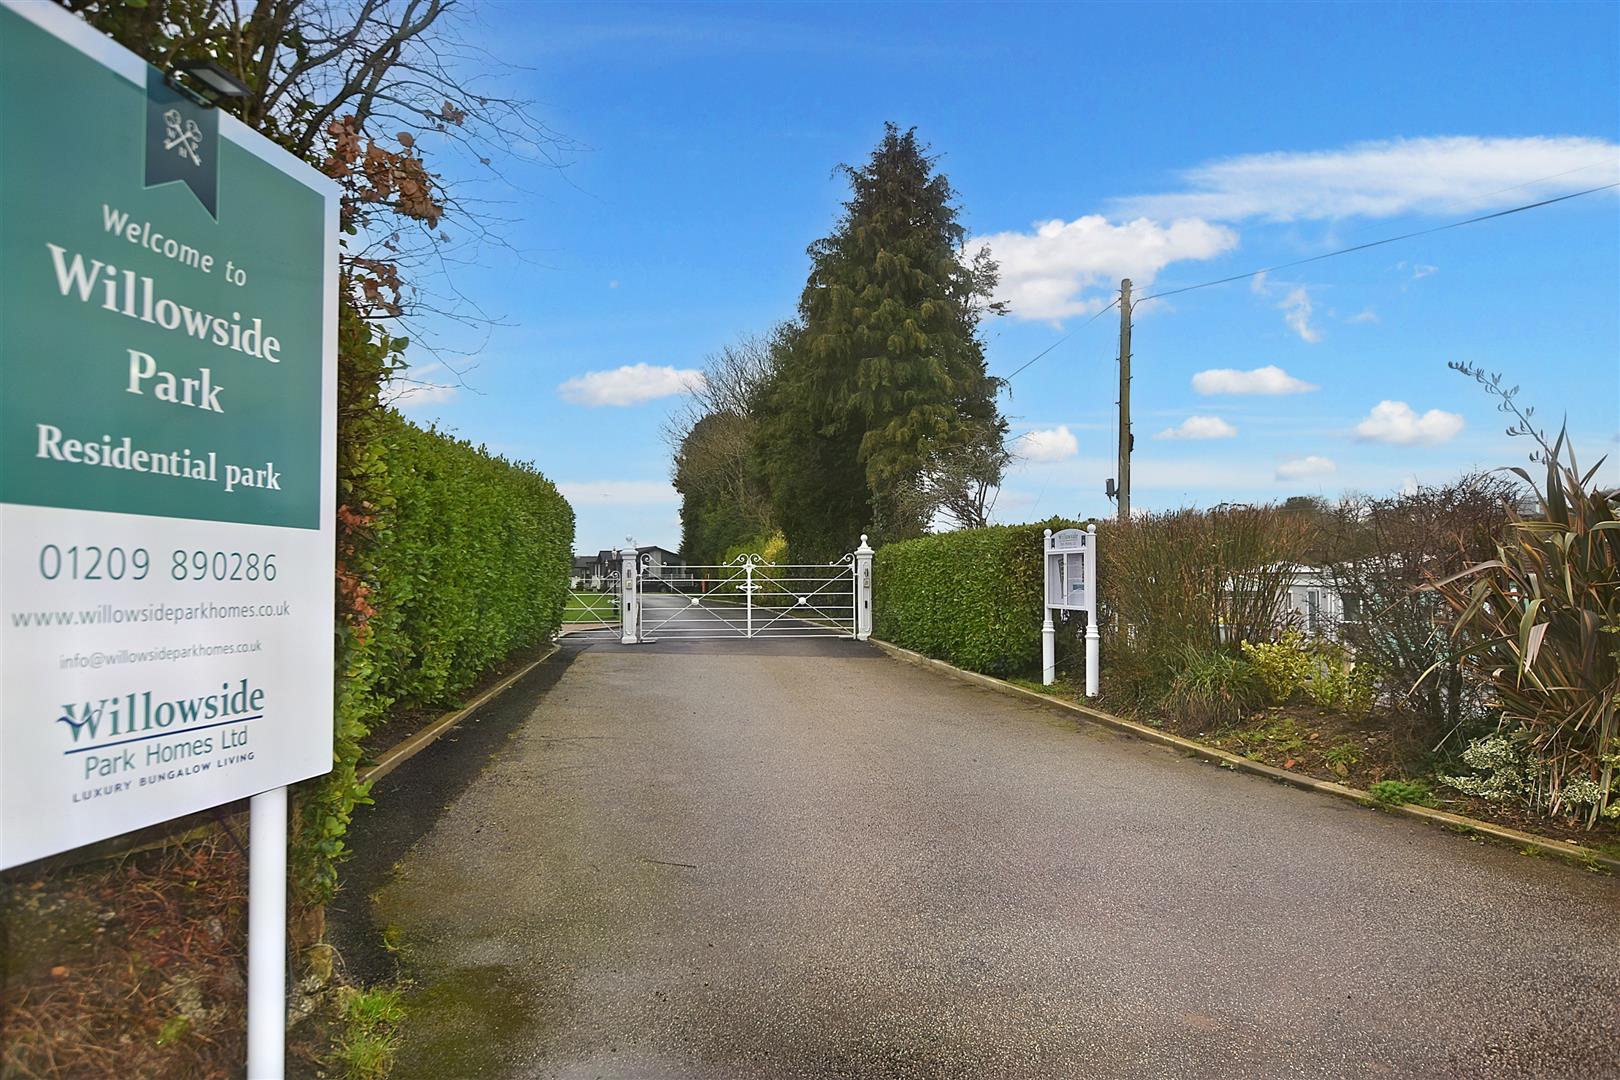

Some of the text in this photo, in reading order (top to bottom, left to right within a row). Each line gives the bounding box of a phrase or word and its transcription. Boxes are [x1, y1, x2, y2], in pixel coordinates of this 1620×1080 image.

[102, 203, 247, 287] Welcome to
[46, 242, 281, 363] Willowside
[126, 348, 225, 414] Park
[36, 423, 282, 492] Residential park
[39, 544, 278, 582] 01209 890286
[11, 600, 291, 628] www.willowsideparkhomes.co.uk
[59, 640, 262, 670] info@willowsideparkhomes.co.uk
[57, 678, 265, 743] Willowside
[72, 752, 256, 804] LUXURY BUNGALOW LIVING
[85, 726, 249, 780] Park Homes Ltd
